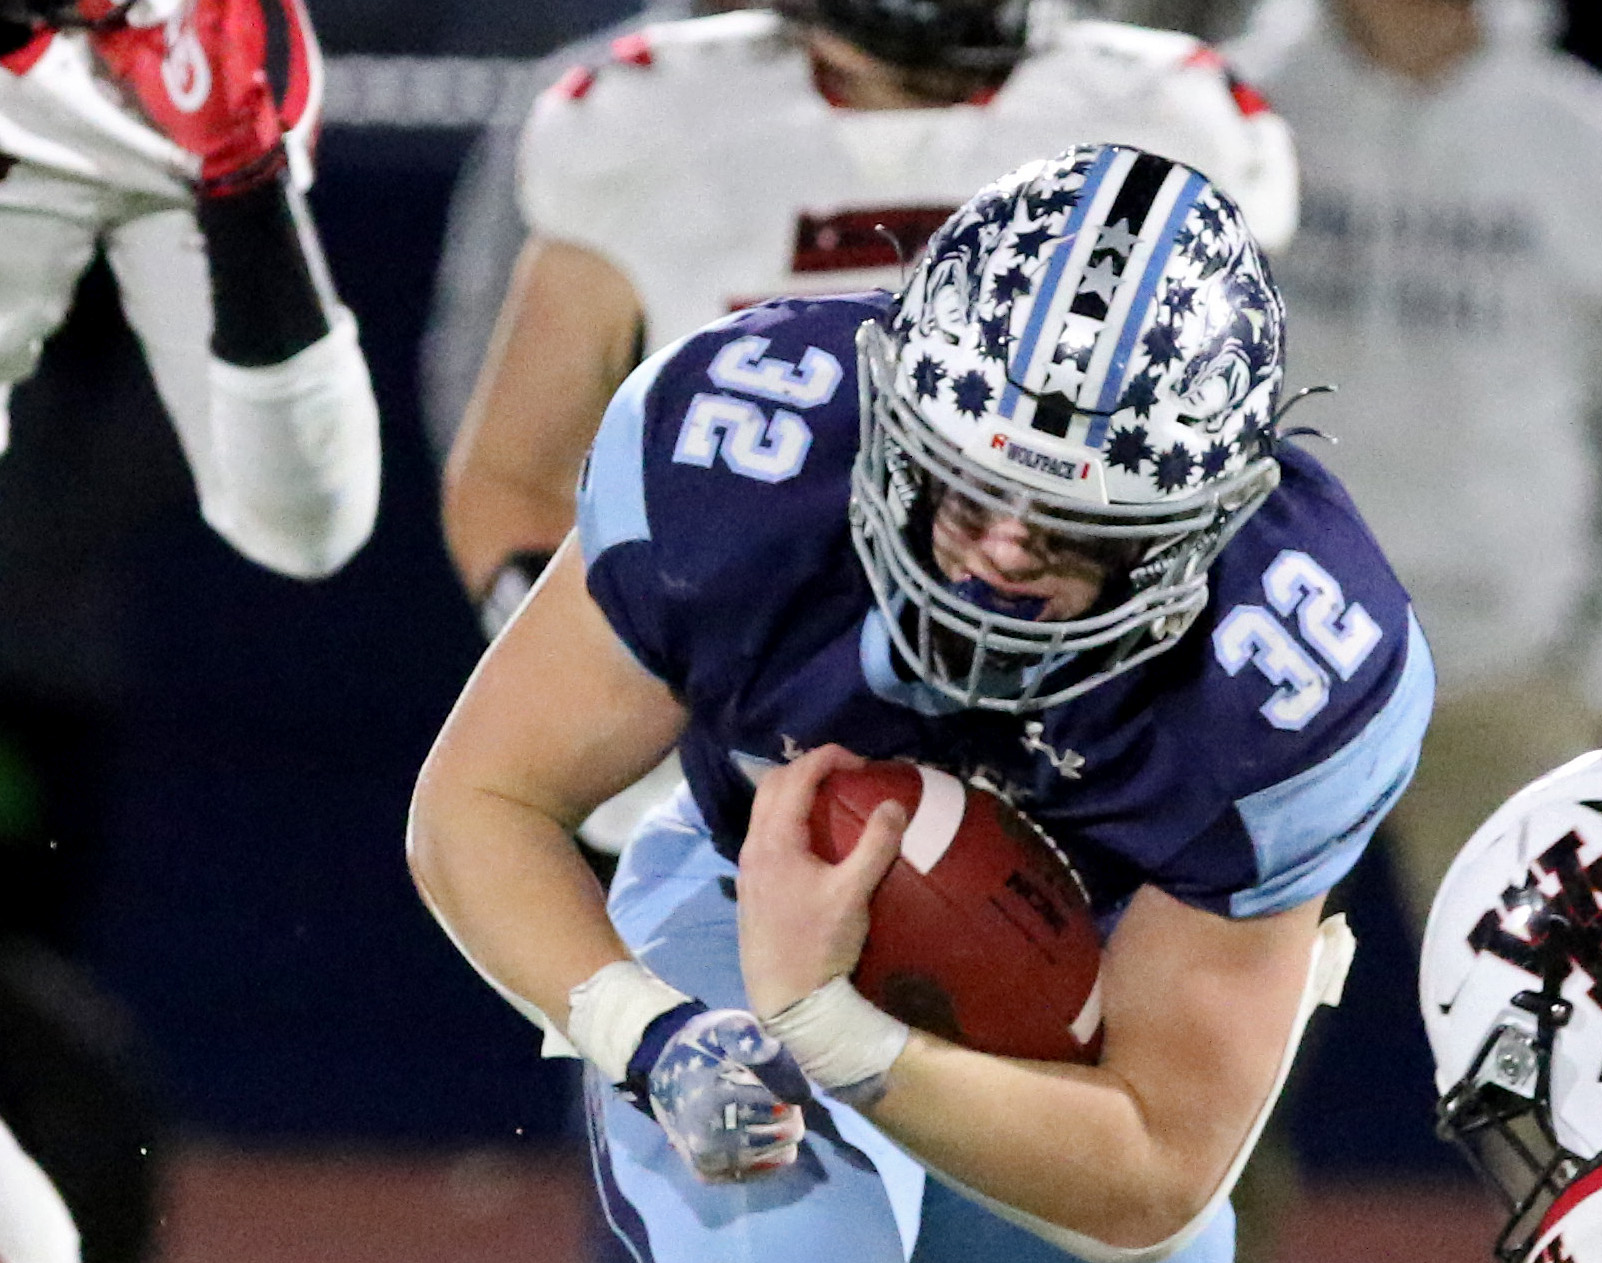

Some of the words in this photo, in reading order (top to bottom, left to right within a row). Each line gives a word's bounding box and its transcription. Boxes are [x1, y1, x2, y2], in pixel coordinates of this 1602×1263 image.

[672, 336, 843, 484] 32
[1006, 441, 1077, 480] WOLFPACK
[1212, 549, 1384, 731] 32
